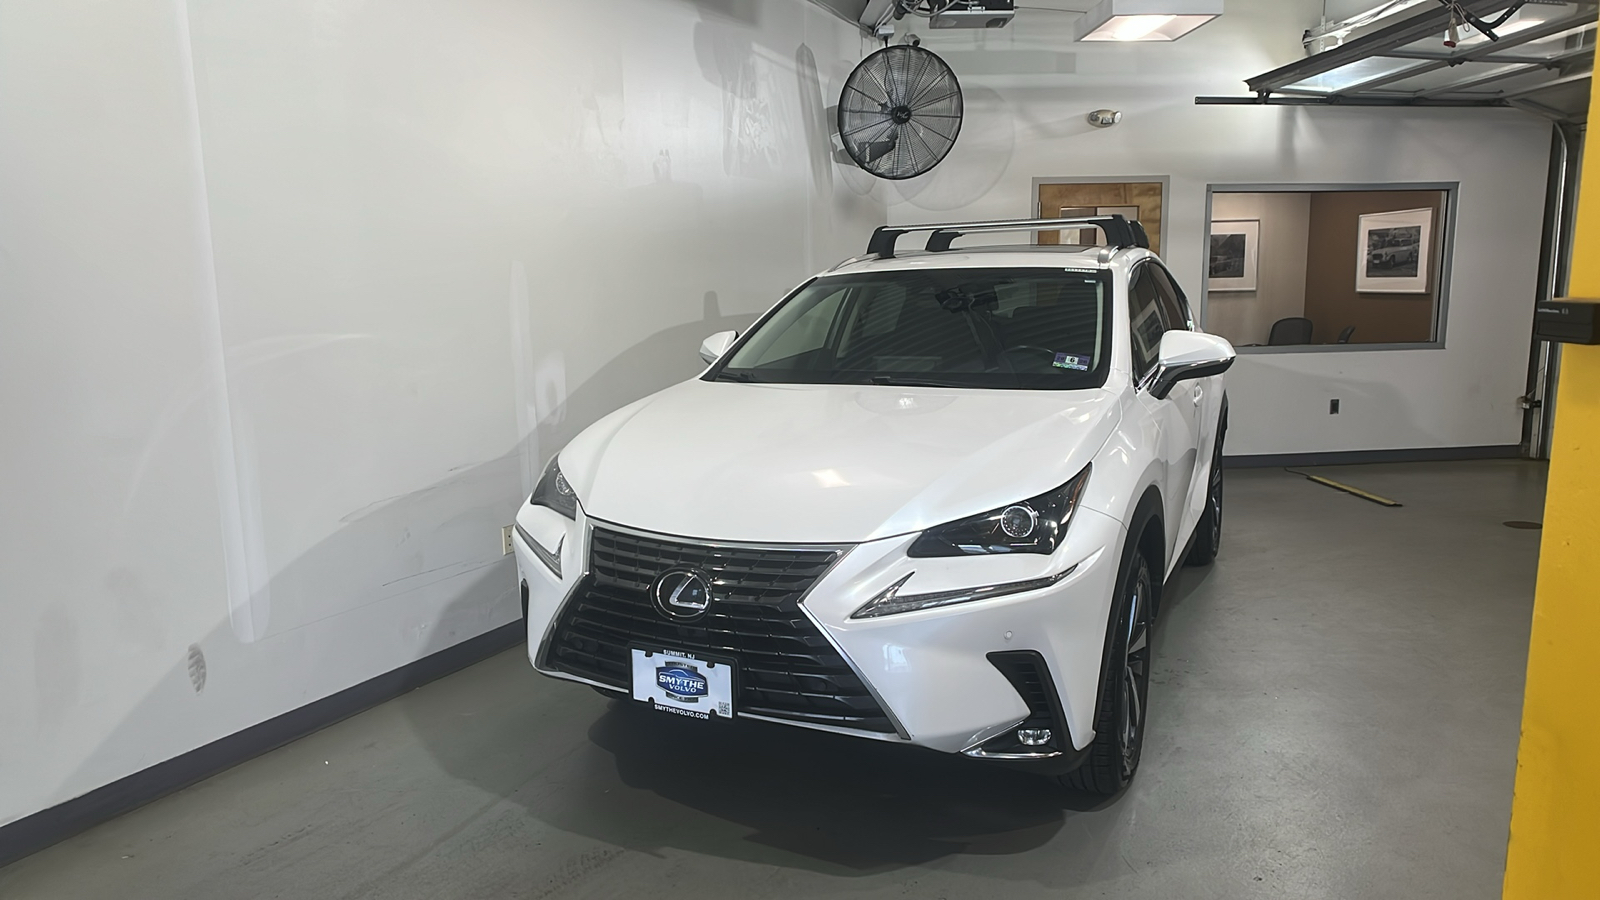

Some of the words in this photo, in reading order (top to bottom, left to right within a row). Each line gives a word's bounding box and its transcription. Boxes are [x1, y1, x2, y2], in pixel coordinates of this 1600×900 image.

[659, 675, 704, 690] SMYTHE
[669, 683, 697, 693] VOLVO
[654, 704, 709, 720] SMYTHEVOLVO.COM
